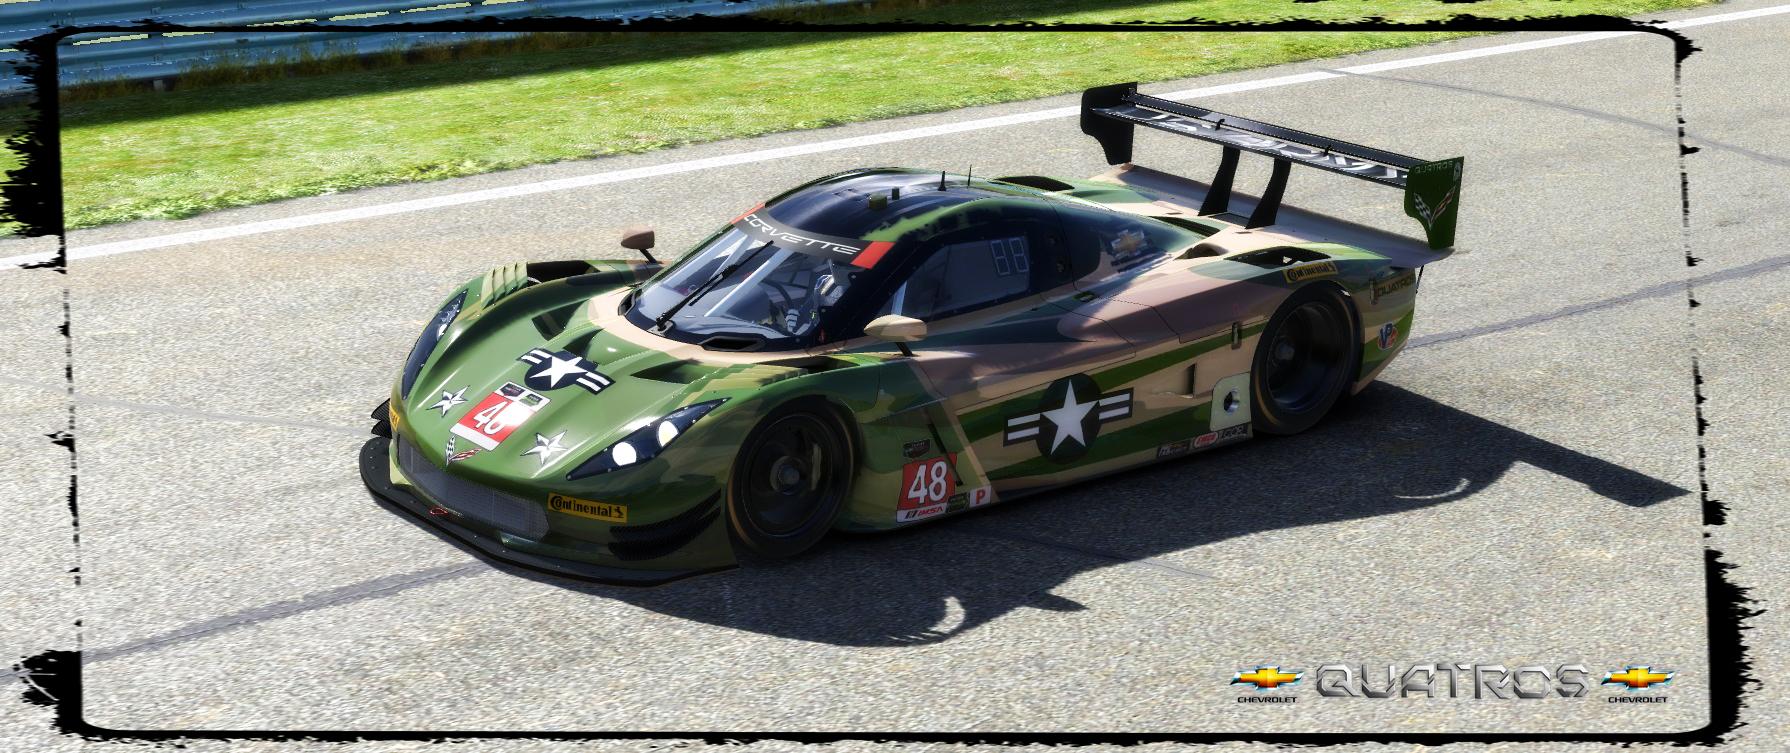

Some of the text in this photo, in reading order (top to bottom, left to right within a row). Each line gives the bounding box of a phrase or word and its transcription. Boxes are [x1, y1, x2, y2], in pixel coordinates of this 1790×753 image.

[744, 213, 861, 255] CORVETTE
[908, 461, 947, 504] 48
[976, 489, 986, 504] P
[551, 496, 612, 517] Continental
